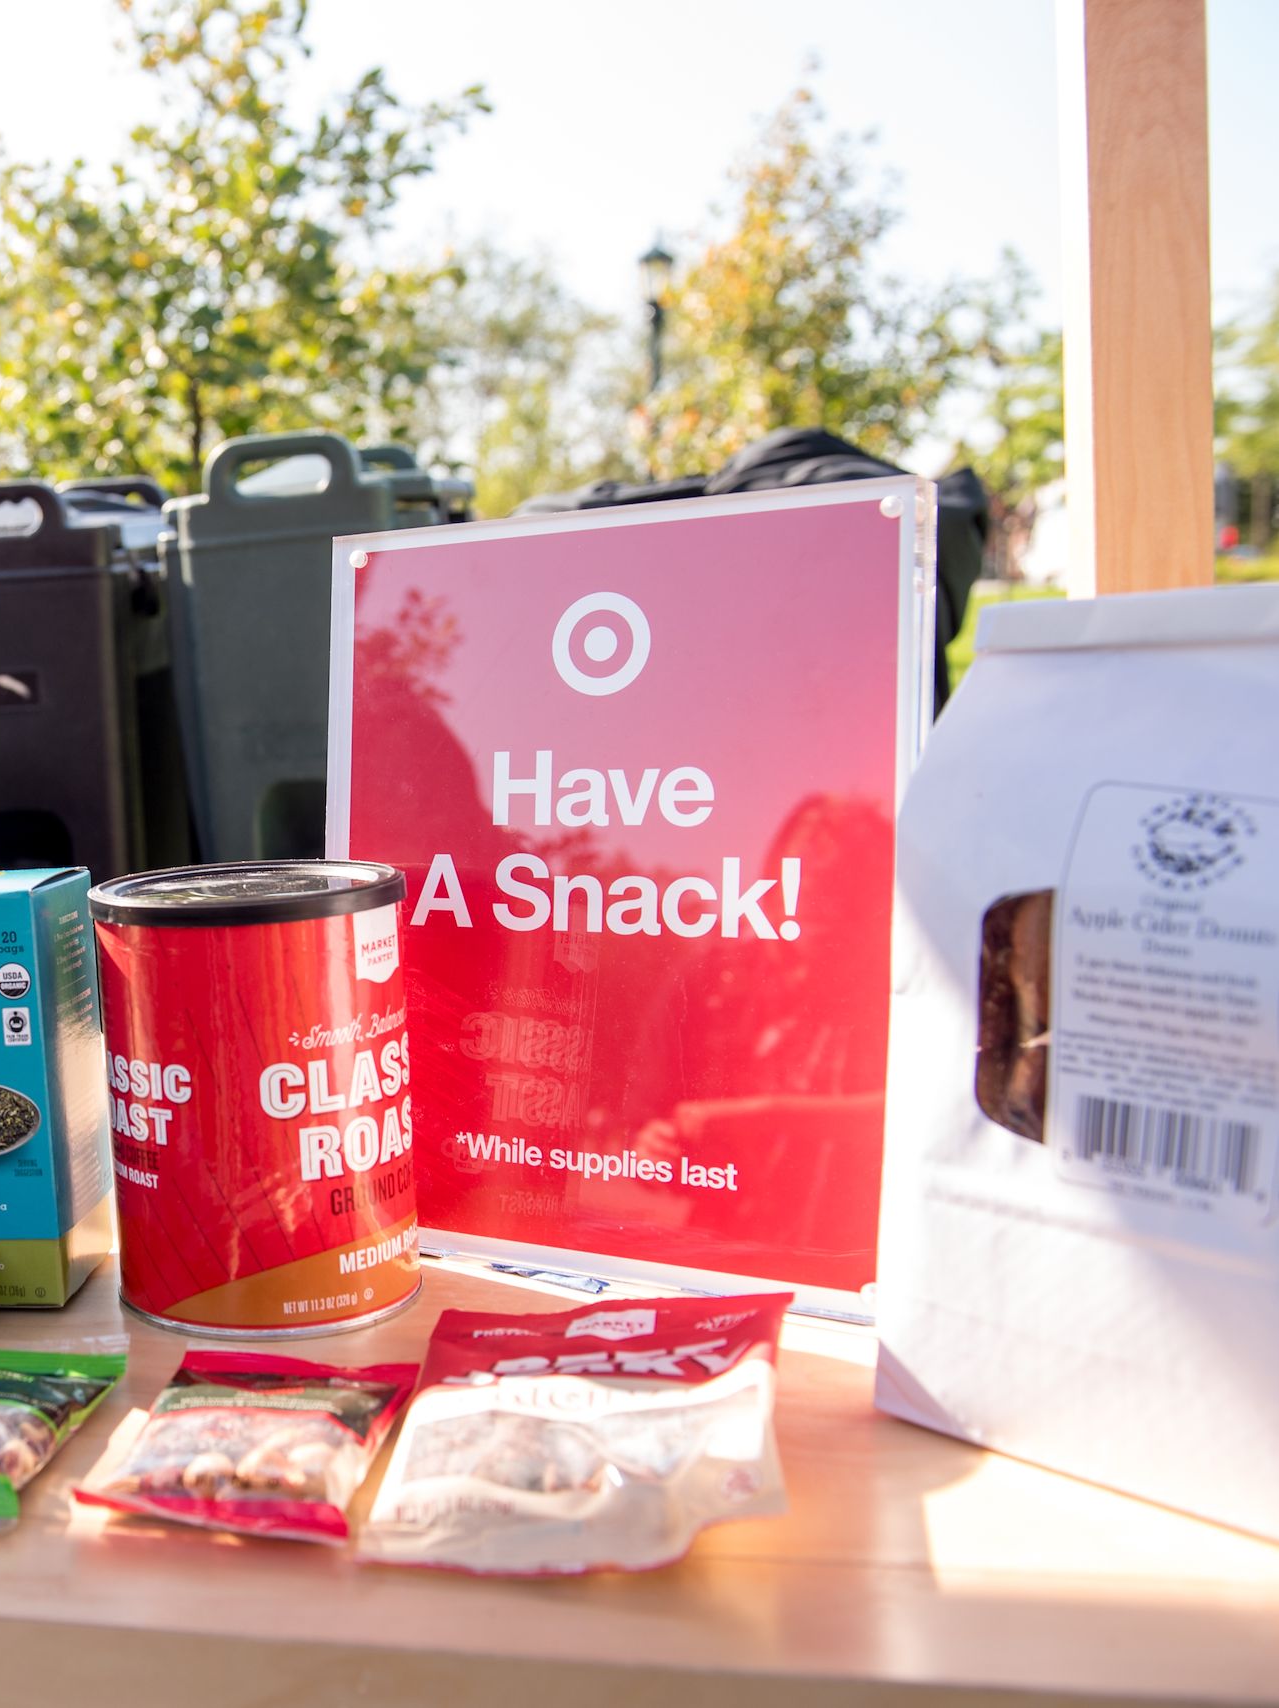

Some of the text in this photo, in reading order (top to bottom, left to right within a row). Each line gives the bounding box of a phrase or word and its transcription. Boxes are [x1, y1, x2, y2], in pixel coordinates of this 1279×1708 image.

[492, 750, 715, 828] Have
[410, 852, 802, 942] A Snack!
[1, 931, 17, 944] 20
[361, 935, 396, 957] MARKET
[367, 951, 394, 967] PANTRY
[2, 972, 23, 980] USDA
[302, 1013, 364, 1050] Smooth,
[128, 1167, 159, 1189] ROAST
[549, 1144, 673, 1186] supplies
[680, 1157, 738, 1192] last
[330, 1172, 395, 1216] GROUND
[339, 1234, 402, 1274] MEDIUM
[283, 1301, 297, 1314] NET
[297, 1300, 308, 1313] WT
[310, 1298, 325, 1311] 11.3
[326, 1296, 335, 1309] OZ
